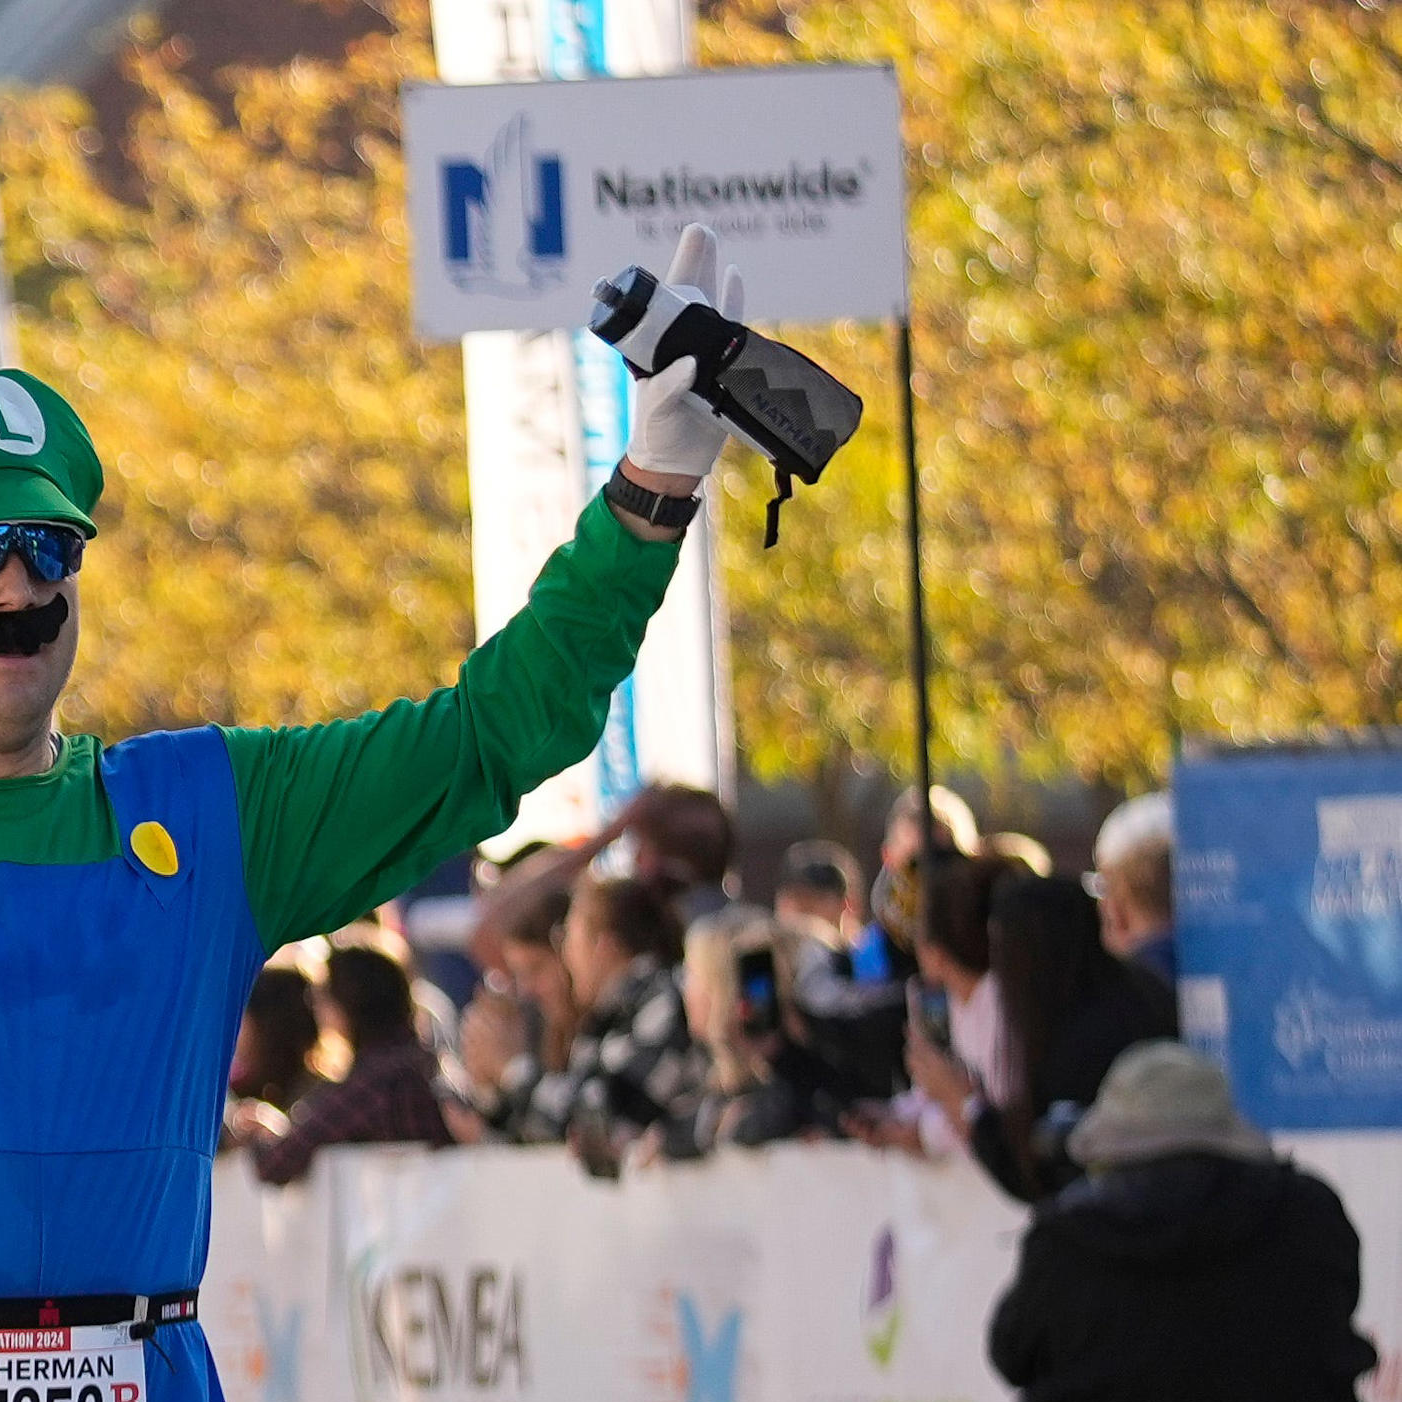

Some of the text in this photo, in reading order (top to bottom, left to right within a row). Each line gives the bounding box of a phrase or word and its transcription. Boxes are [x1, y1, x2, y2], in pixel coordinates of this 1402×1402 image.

[597, 159, 861, 209] Nationwide
[753, 393, 823, 455] NATHA
[36, 1331, 65, 1348] 2024
